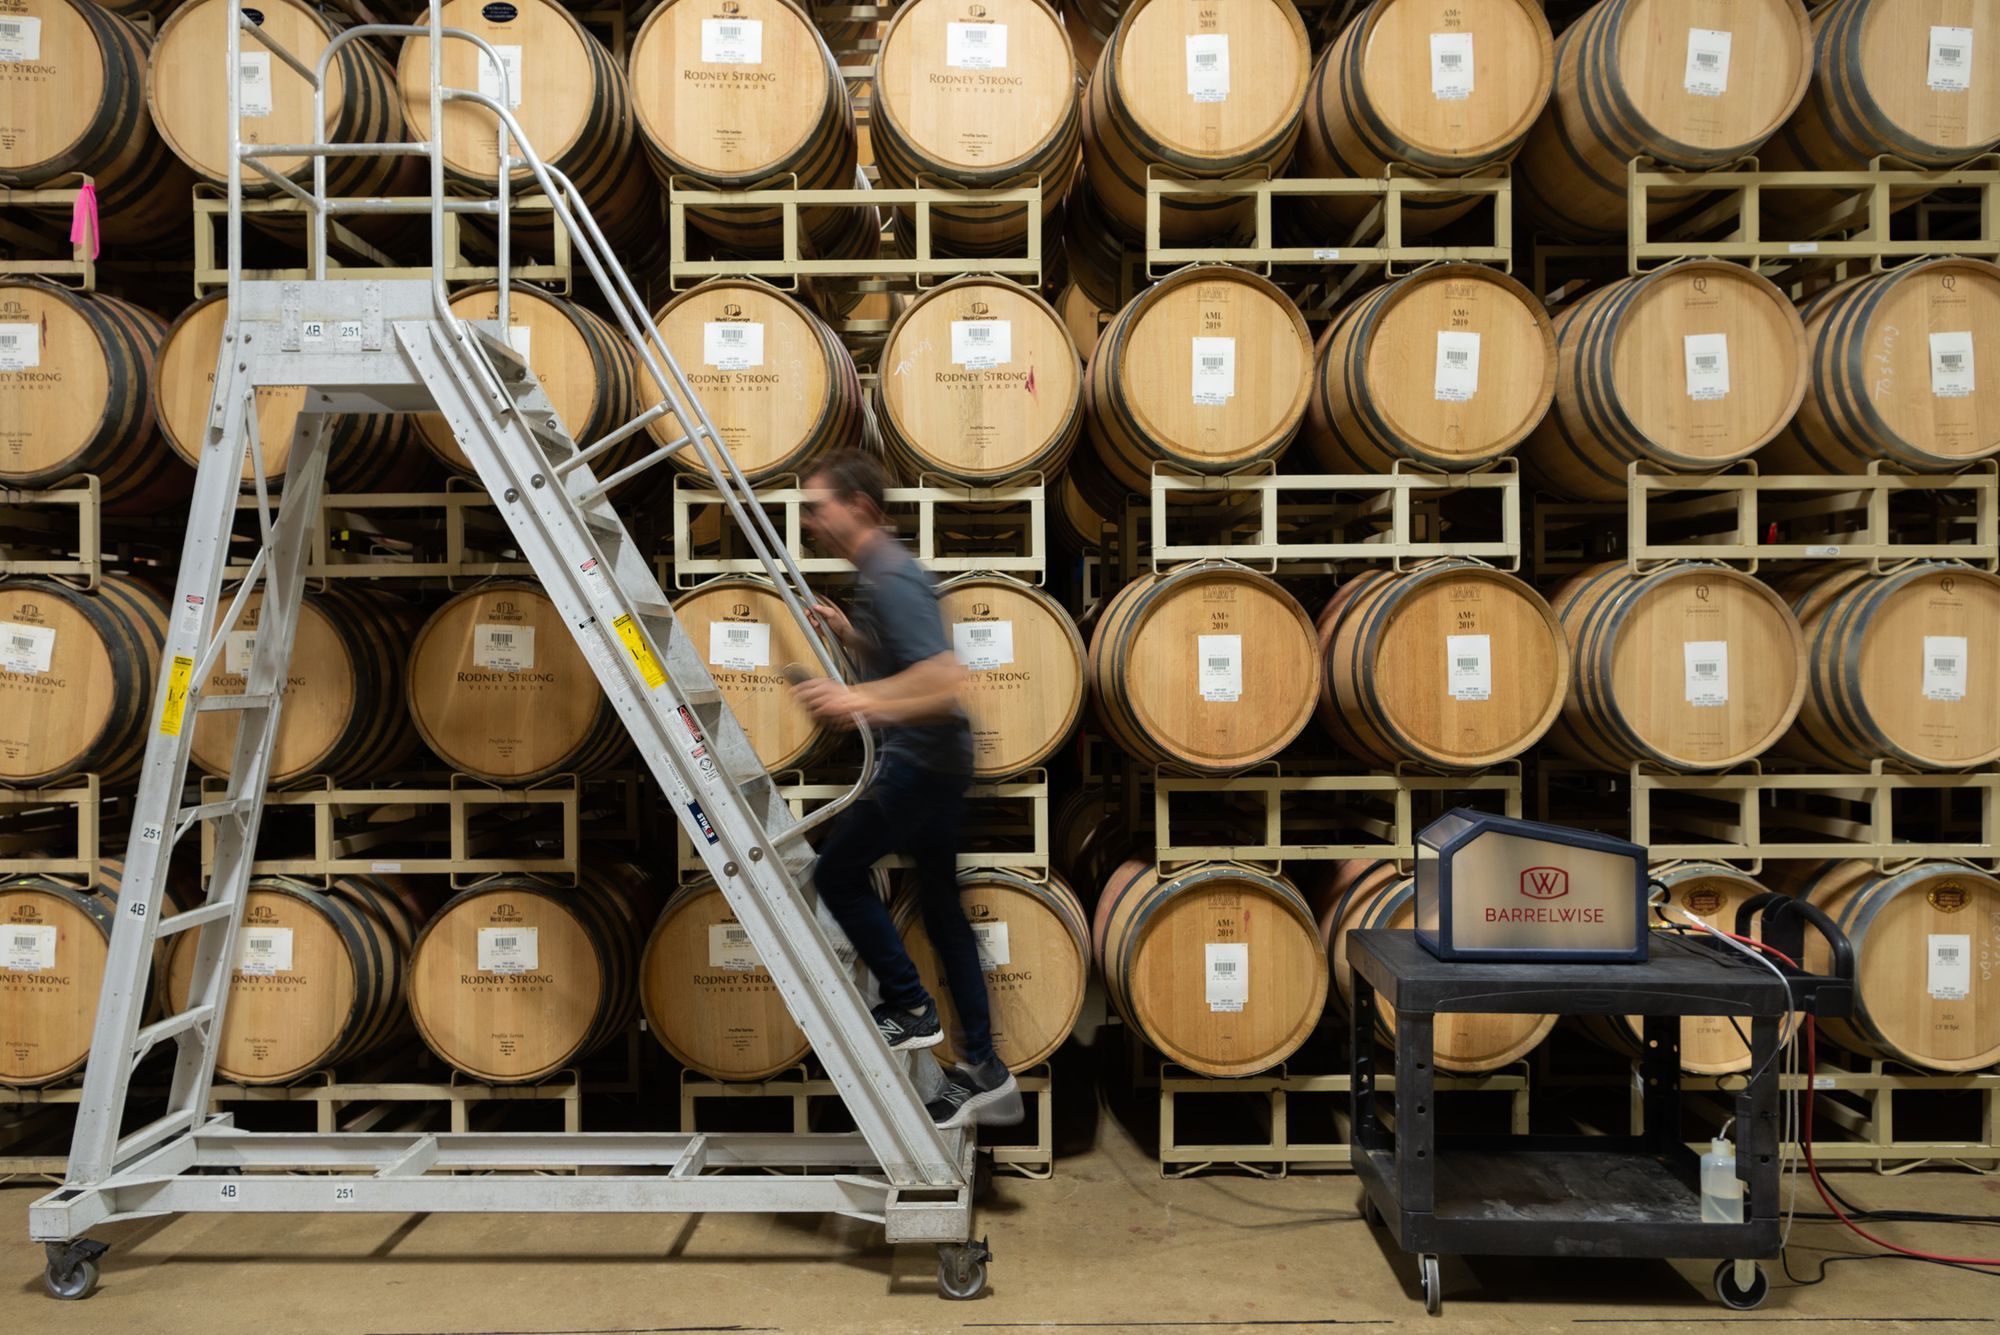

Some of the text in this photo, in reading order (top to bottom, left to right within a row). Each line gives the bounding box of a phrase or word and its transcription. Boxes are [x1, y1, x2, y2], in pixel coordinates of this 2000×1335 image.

[1200, 20, 1216, 28] 2019
[13, 63, 56, 74] STRONG
[684, 70, 776, 82] RODNEY STRONG
[930, 74, 1022, 86] RODNEY STRONG
[306, 324, 360, 337] 4B 251
[1205, 322, 1222, 330] 2019
[16, 372, 62, 382] STRONG
[687, 374, 780, 384] RODNEY STRONG
[936, 372, 1027, 382] RODNEY STRONG
[1212, 622, 1228, 630] 2019
[24, 674, 66, 688] STRONG
[458, 672, 554, 682] RODNEY STRONG
[740, 673, 784, 685] STRONG
[986, 672, 1030, 682] STRONG
[144, 827, 161, 839] 251
[130, 902, 146, 916] 4B
[1486, 908, 1604, 923] BARRELWISE
[1217, 929, 1234, 937] 2019
[27, 974, 70, 985] STRONG
[265, 975, 307, 985] STRONG
[461, 974, 553, 984] RODNEY STRONG
[694, 974, 738, 984] RODNEY
[988, 972, 1032, 983] STRONG
[221, 1185, 354, 1199] 4B 251
